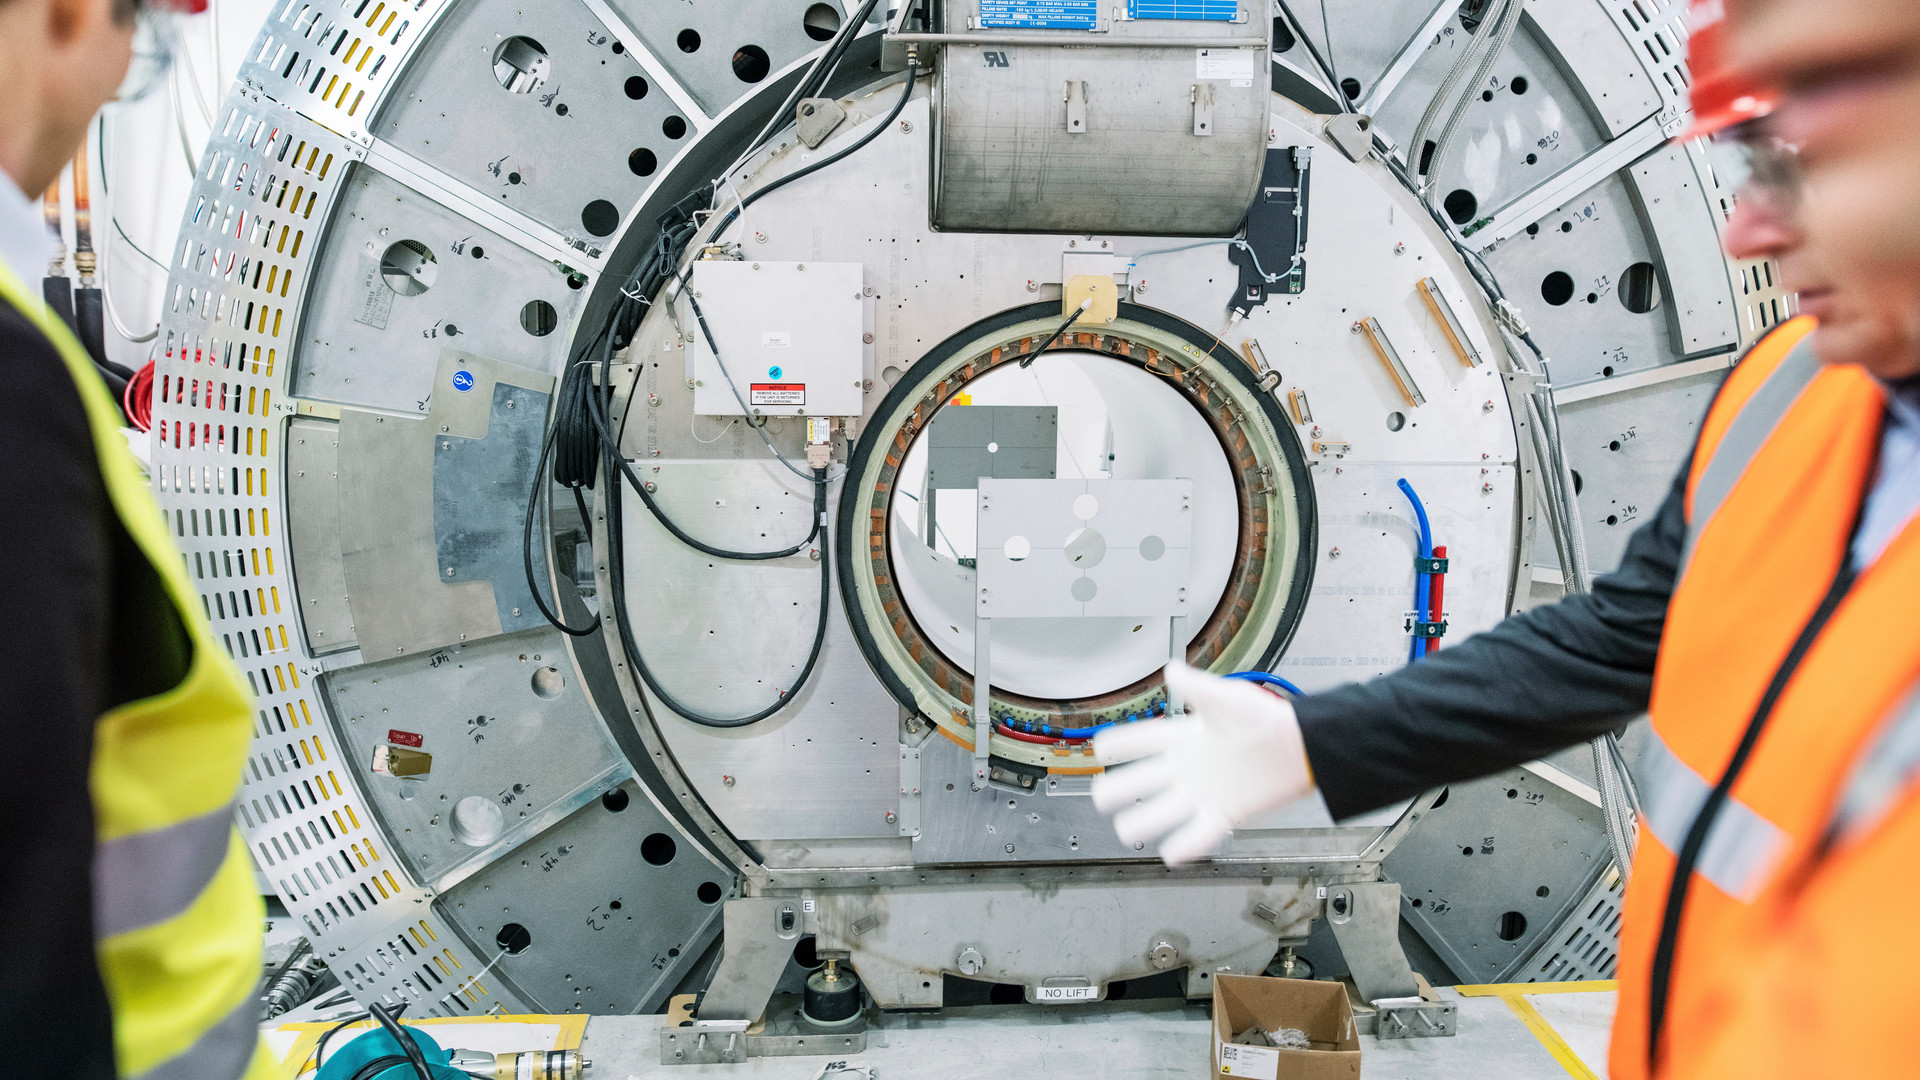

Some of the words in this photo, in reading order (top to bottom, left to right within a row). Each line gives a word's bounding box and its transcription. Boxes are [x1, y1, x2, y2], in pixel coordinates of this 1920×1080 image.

[1613, 352, 1628, 362] 23
[1320, 889, 1325, 897] L
[805, 902, 811, 910] E
[1045, 989, 1062, 997] NO
[1066, 989, 1089, 997] LIFT
